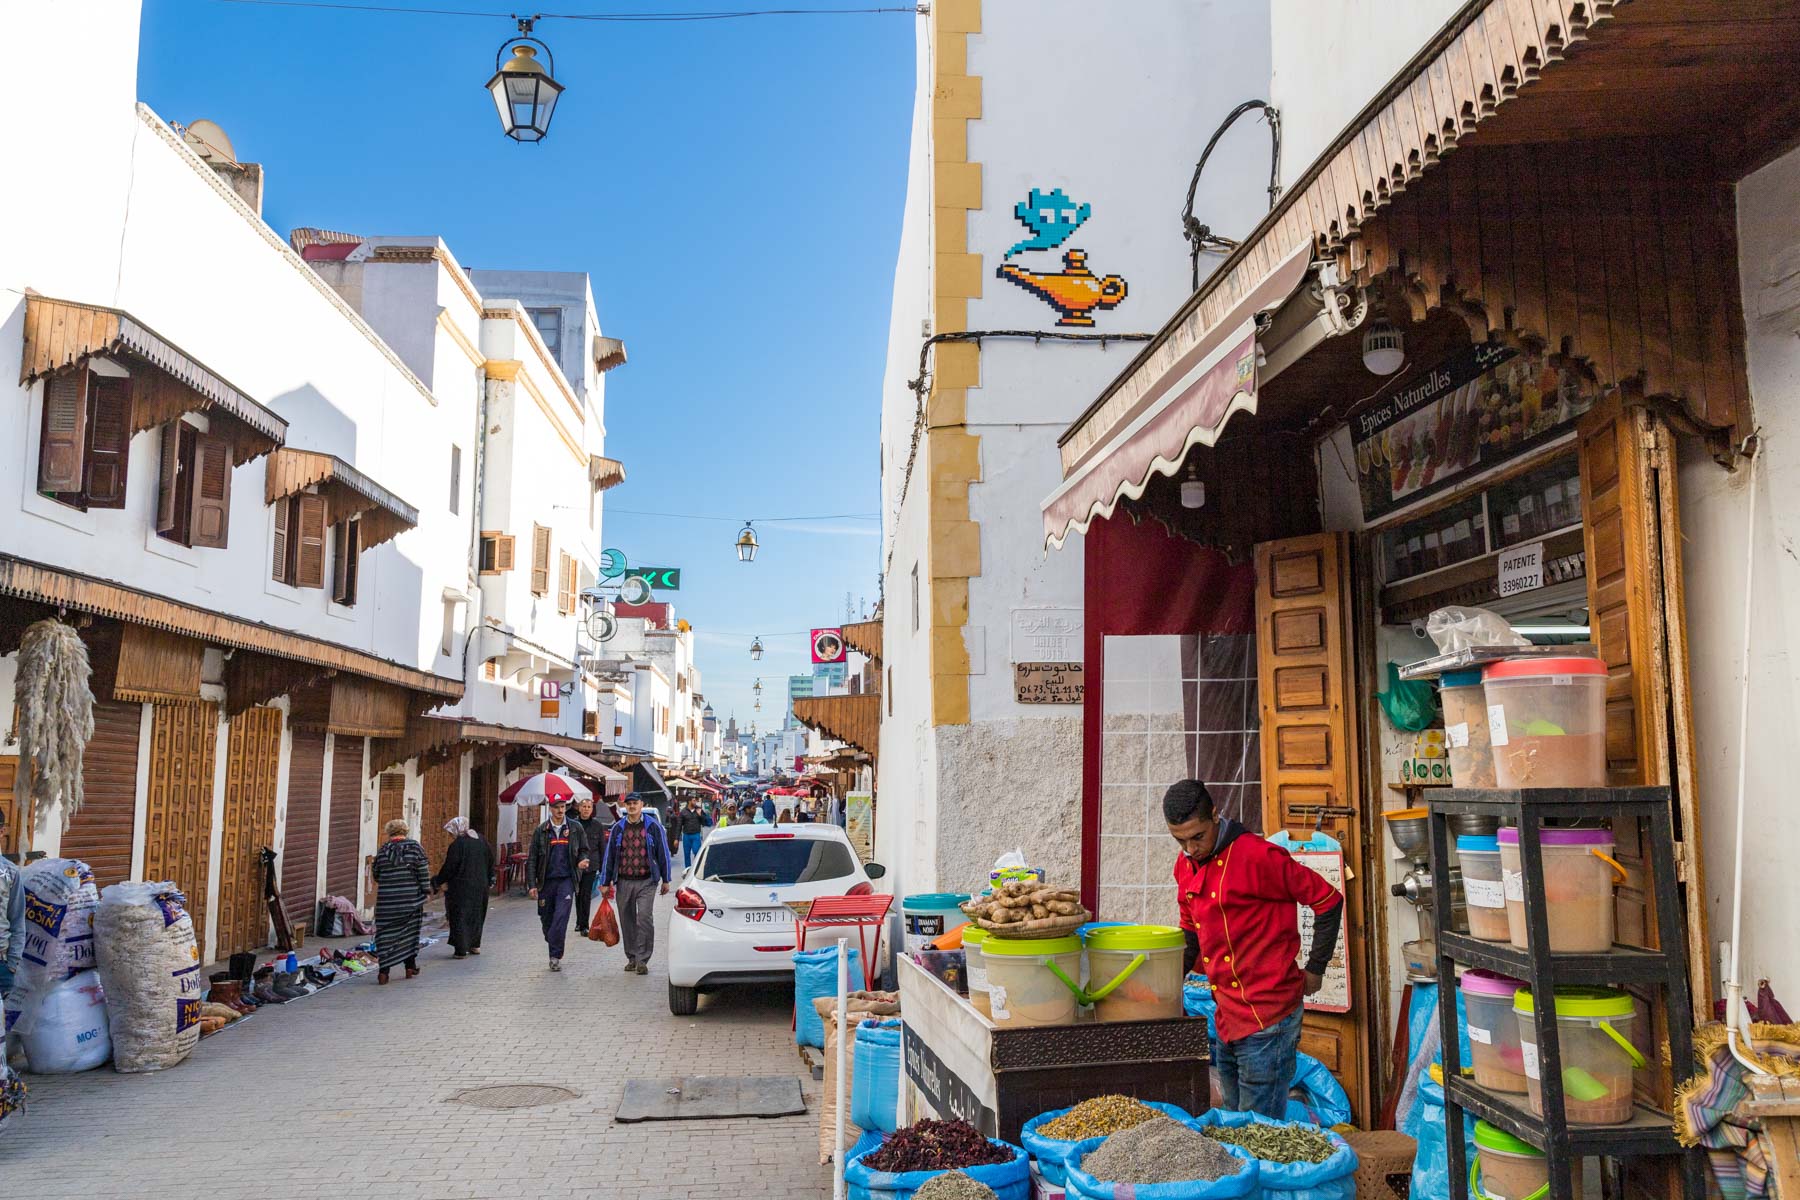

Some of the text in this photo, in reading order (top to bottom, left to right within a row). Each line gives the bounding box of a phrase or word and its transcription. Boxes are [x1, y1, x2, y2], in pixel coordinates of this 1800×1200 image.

[1360, 371, 1450, 435] Epices Naturelles
[1503, 553, 1536, 572] PATENTE
[1503, 574, 1538, 593] 33960227
[1041, 662, 1083, 677] حانوت
[745, 912, 772, 923] 91375
[918, 918, 939, 926] DIAMANT
[922, 926, 935, 934] NOIR
